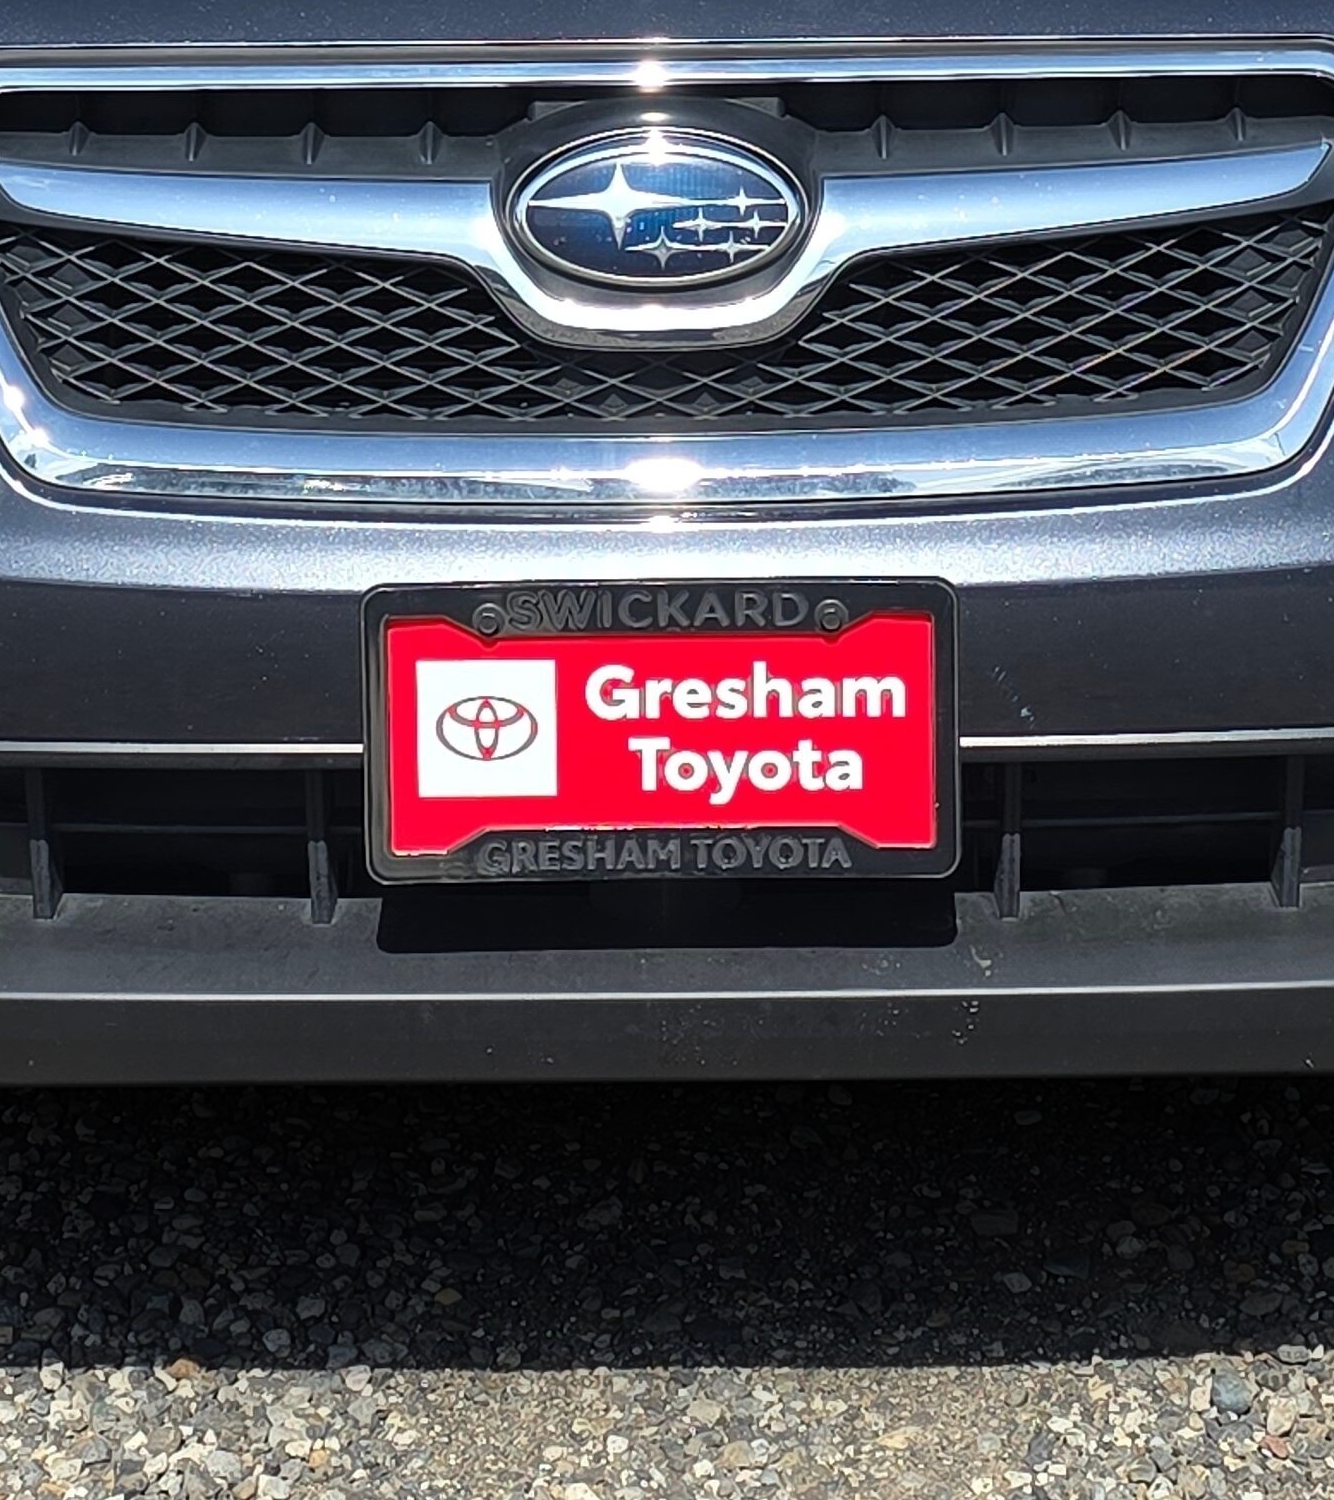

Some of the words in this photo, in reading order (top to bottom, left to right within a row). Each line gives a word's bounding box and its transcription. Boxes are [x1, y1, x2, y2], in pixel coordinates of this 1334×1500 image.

[506, 590, 809, 631] SWICKARD
[584, 661, 907, 721] Gresham
[627, 736, 864, 805] Toyota
[480, 836, 680, 874] GRESHAM
[691, 836, 853, 870] TOYOTA
